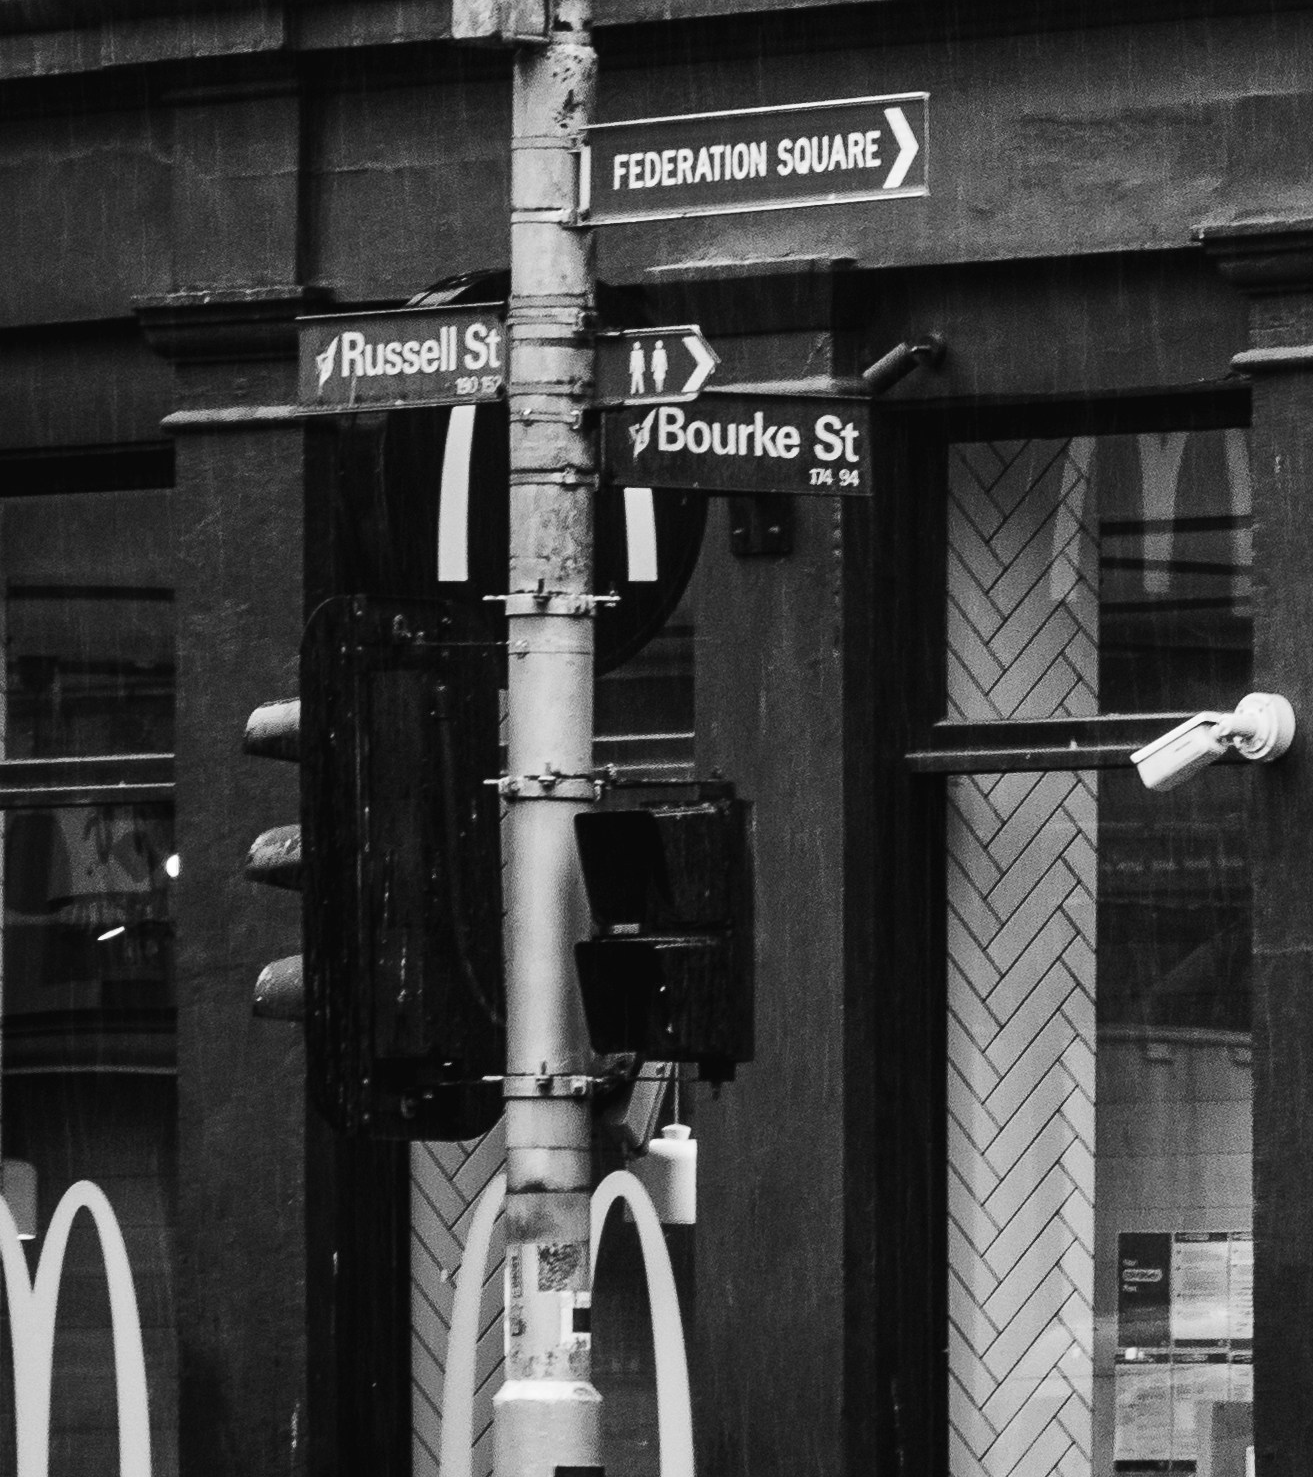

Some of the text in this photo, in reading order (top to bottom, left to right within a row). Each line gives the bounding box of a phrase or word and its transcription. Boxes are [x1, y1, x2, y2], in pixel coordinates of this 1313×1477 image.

[613, 130, 882, 190] FEDERATION SQUARE
[341, 322, 502, 378] Russell St
[657, 406, 861, 463] Bourke St
[809, 467, 861, 488] 174 94
